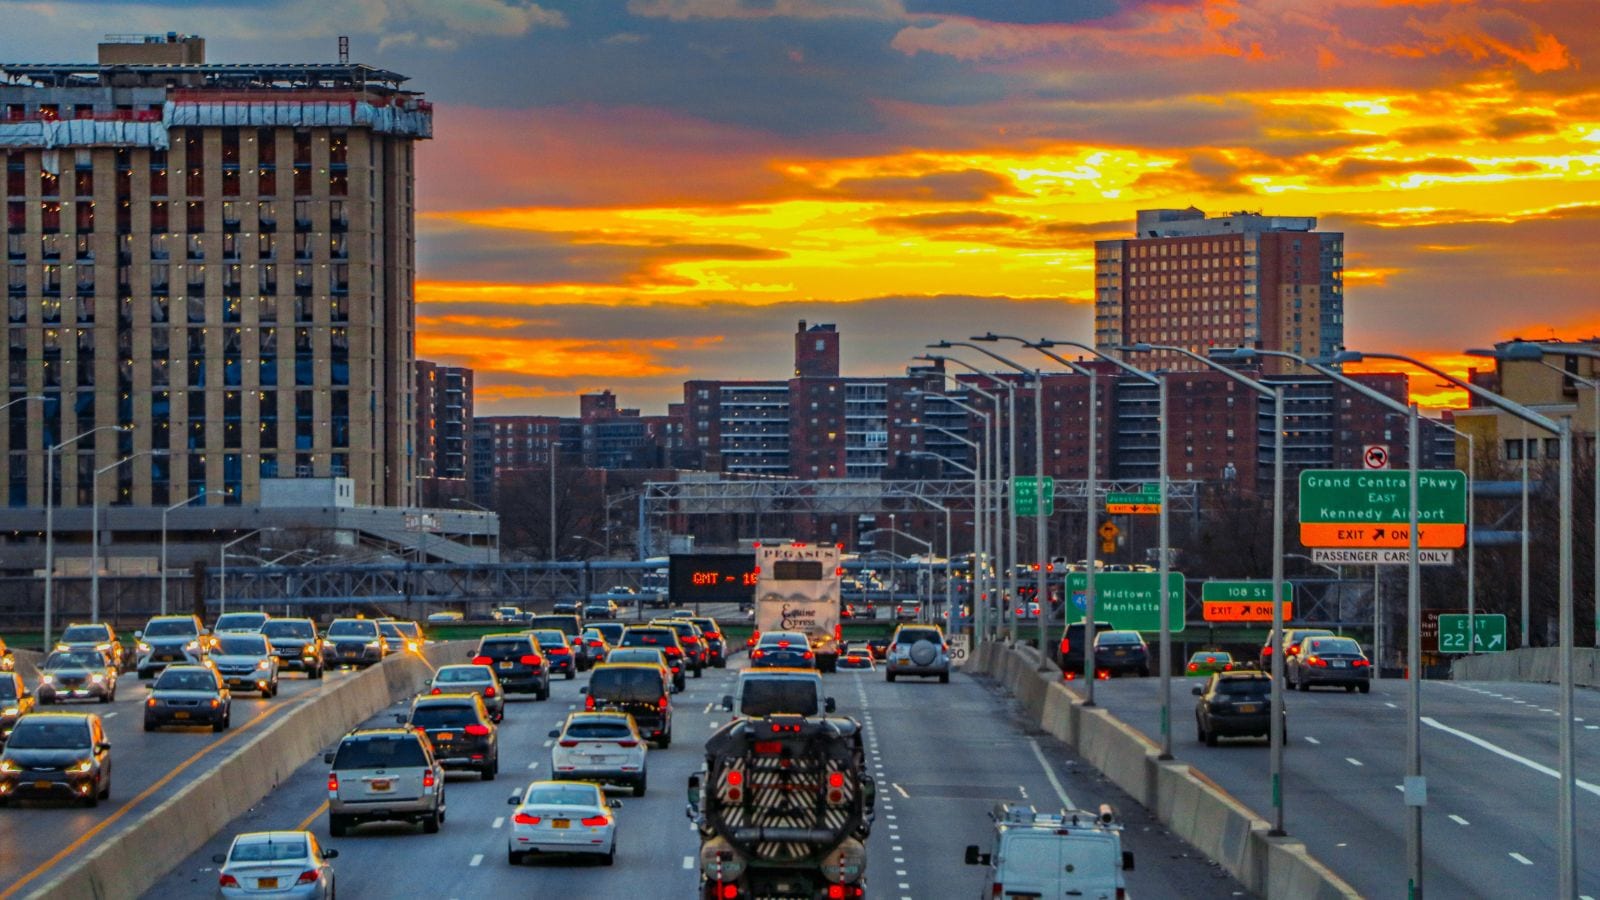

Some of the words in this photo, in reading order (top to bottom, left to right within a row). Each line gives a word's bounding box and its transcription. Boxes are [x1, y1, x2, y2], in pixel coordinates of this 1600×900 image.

[1307, 476, 1350, 488] Grand
[1420, 476, 1457, 490] Pkwy
[1368, 492, 1396, 502] EAST
[1320, 508, 1382, 521] Kennedy
[1392, 508, 1445, 520] Aiport
[1337, 530, 1365, 540] EXIT
[1391, 530, 1425, 540] ONY
[1315, 551, 1378, 562] PASSENGER
[1384, 551, 1411, 562] CARS
[1419, 551, 1449, 562] ONLY
[1103, 590, 1152, 599] Midtown
[1228, 587, 1248, 597] 108
[1254, 587, 1267, 597] St
[1103, 603, 1161, 611] Manhatta
[1211, 606, 1232, 615] EXIT
[1256, 606, 1274, 615] ONL
[1457, 620, 1487, 629] EIT
